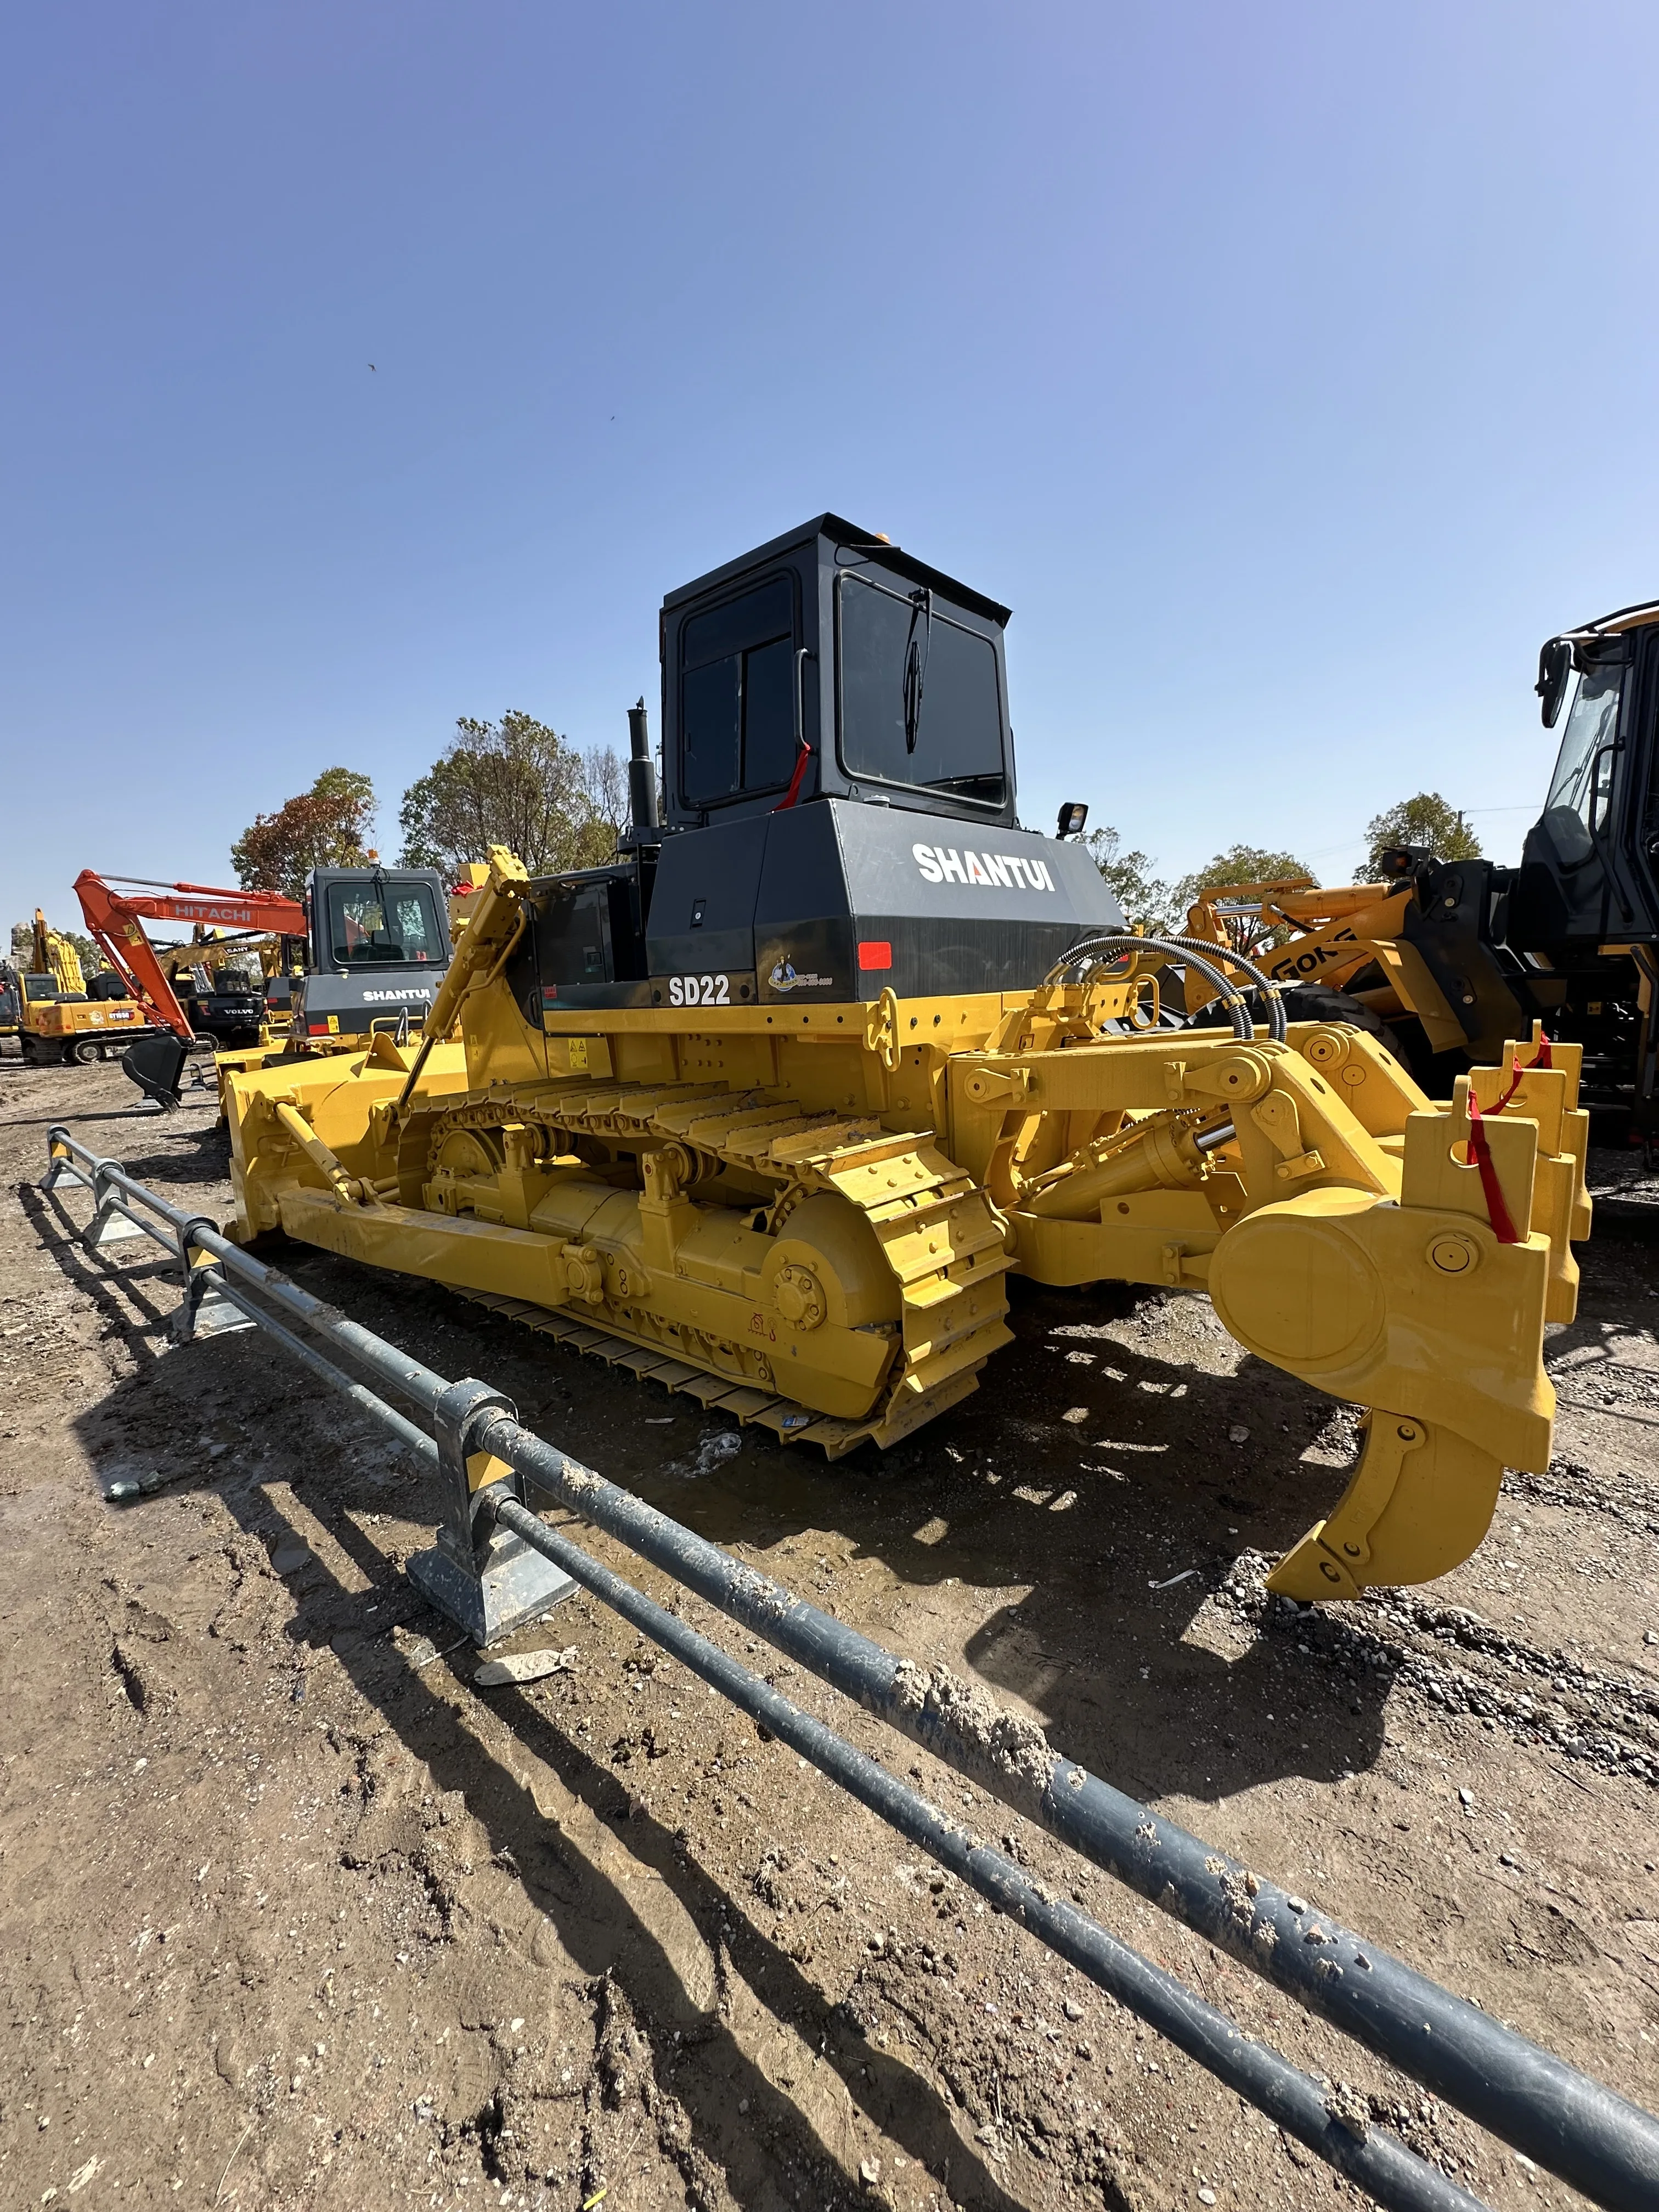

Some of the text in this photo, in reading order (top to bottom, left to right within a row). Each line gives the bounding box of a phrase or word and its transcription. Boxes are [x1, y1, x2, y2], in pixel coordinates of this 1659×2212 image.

[912, 843, 1056, 891] SHANTUI
[176, 905, 251, 921] HITACHI
[363, 989, 431, 1001] SHANTUI
[669, 975, 730, 1006] SD22
